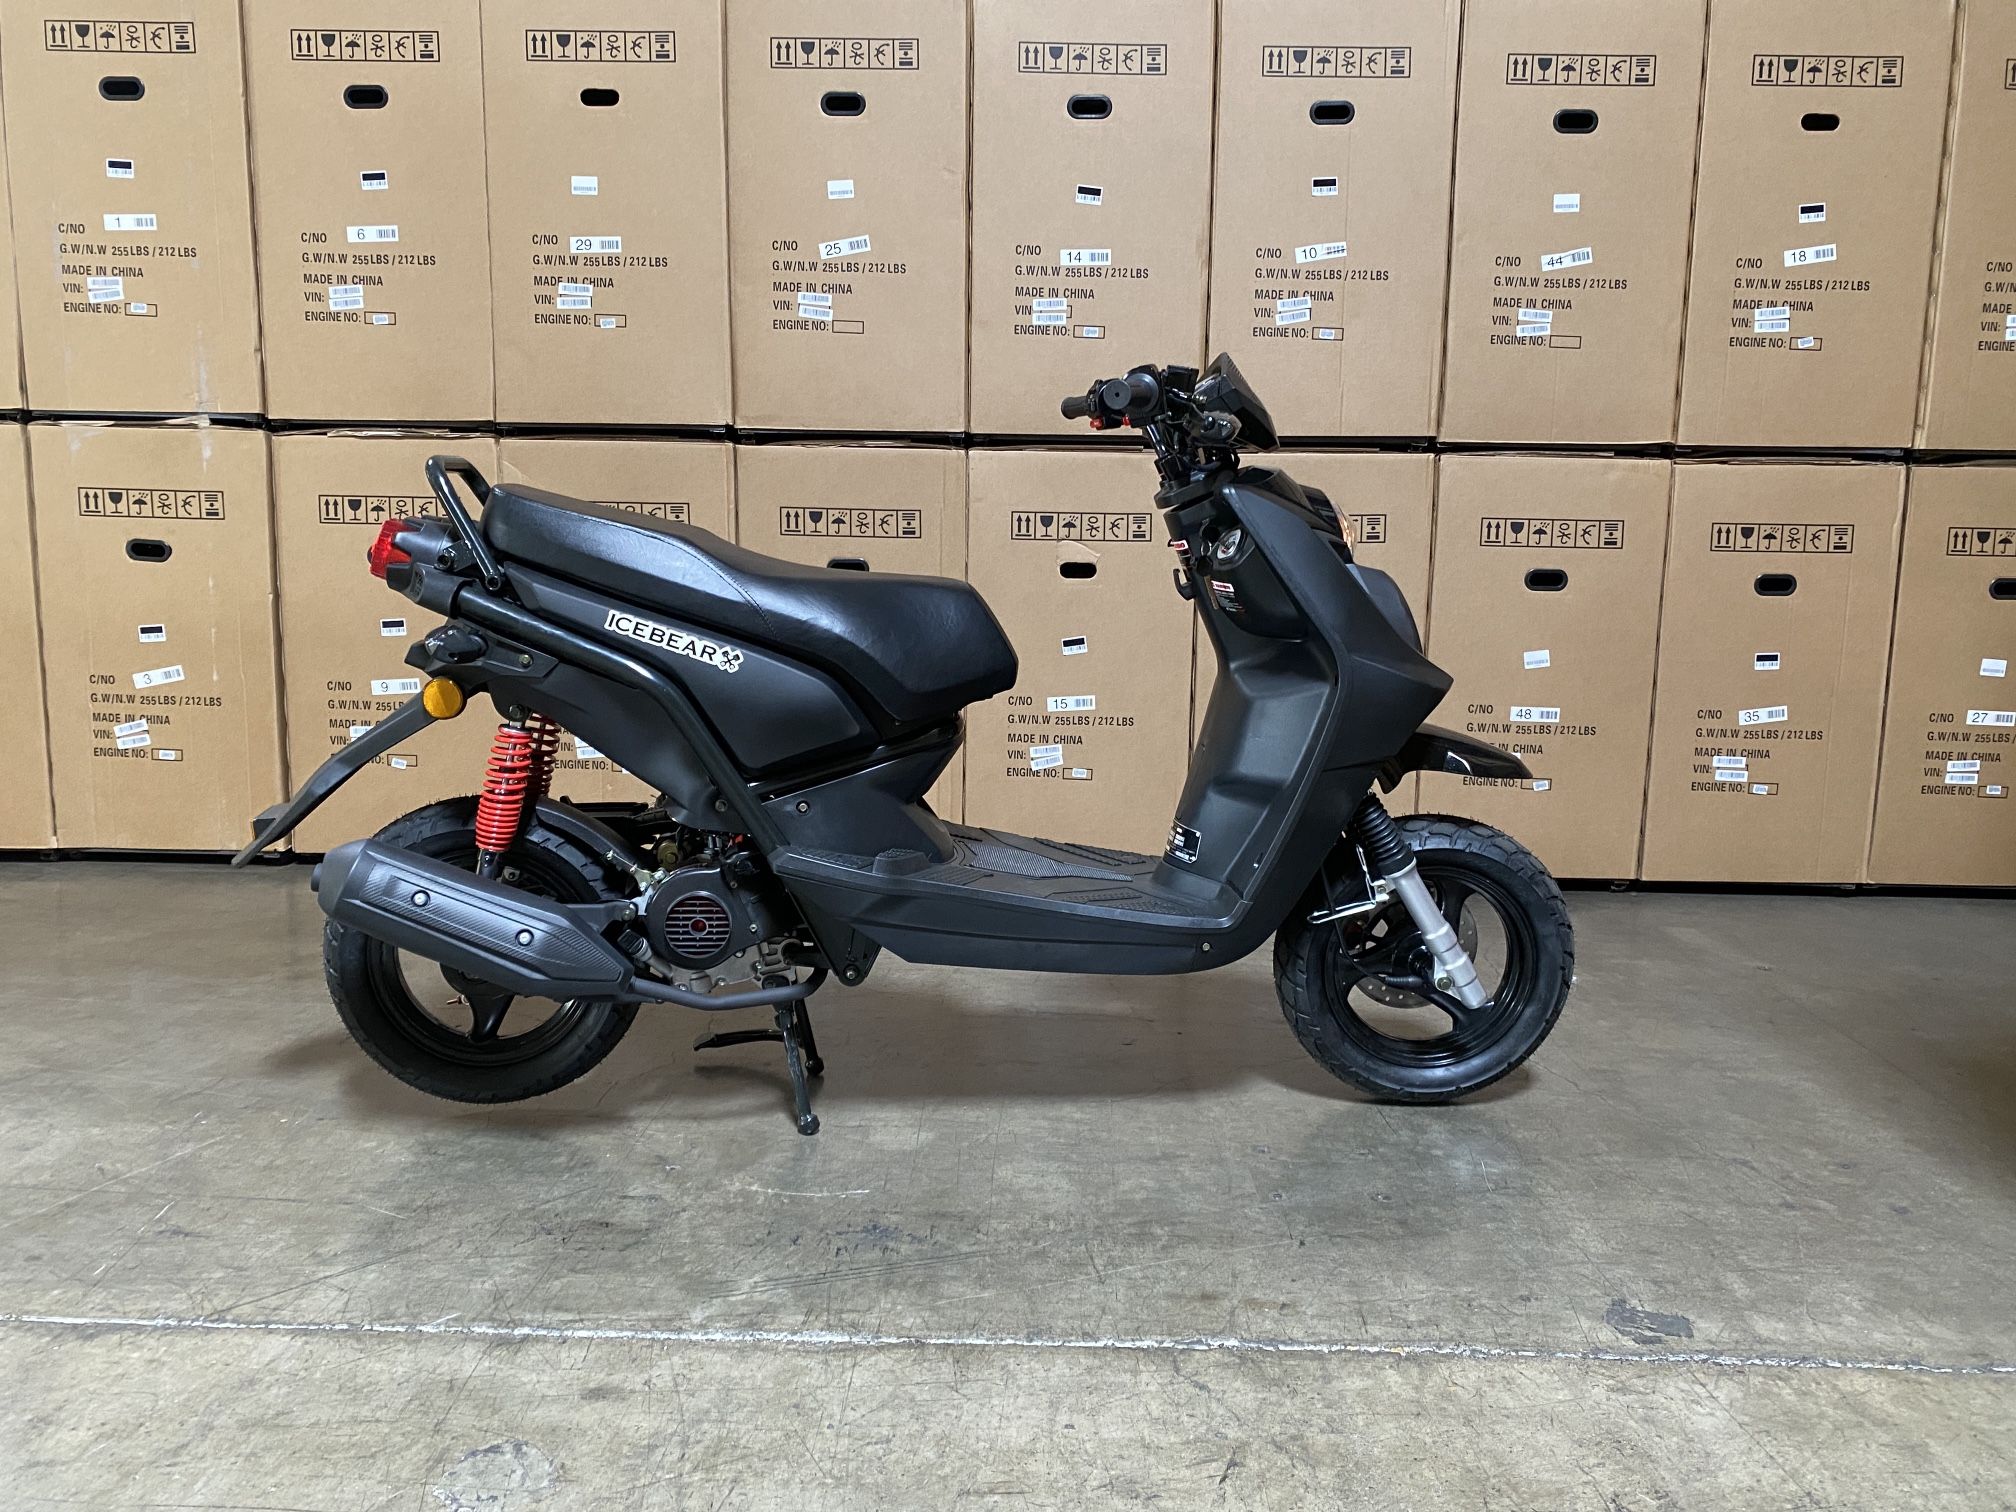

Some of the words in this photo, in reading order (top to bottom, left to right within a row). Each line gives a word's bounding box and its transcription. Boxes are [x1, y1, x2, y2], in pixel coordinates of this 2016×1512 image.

[114, 217, 121, 228] 1
[58, 223, 85, 234] C/NO
[301, 233, 327, 243] C/NO
[357, 228, 365, 240] 6
[532, 234, 558, 245] C/NO
[575, 238, 592, 251] 29
[772, 241, 798, 251] C/NO
[825, 243, 842, 256] 25
[1016, 245, 1041, 256] C/NO
[159, 247, 175, 256] 212
[1256, 248, 1281, 259] C/NO
[1302, 247, 1318, 260] 10
[1791, 250, 1807, 263] 18
[398, 255, 415, 264] 212
[630, 257, 646, 266] 212
[1066, 251, 1082, 263] 14
[1495, 256, 1521, 267] C/NO
[1547, 256, 1563, 268] 44
[869, 263, 885, 273] 212
[1736, 258, 1762, 269] C/NO
[1987, 262, 2012, 272] C/NO
[62, 265, 92, 275] MADE
[96, 266, 106, 276] IN
[112, 267, 143, 277] CHINA
[1111, 268, 1127, 277] 212
[1351, 270, 1367, 280] 212
[304, 274, 333, 284] MADE
[337, 275, 347, 284] IN
[352, 275, 383, 286] CHINA
[1590, 279, 1606, 288] 212
[1831, 280, 1849, 290] 212
[63, 283, 83, 293] VIN:
[773, 282, 802, 292] MADE
[806, 283, 816, 293] IN
[821, 283, 852, 294] CHINA
[1015, 286, 1044, 297] MADE
[1049, 288, 1058, 298] IN
[1064, 288, 1094, 299] CHINA
[304, 292, 324, 302] VIN:
[534, 294, 554, 304] VIN:
[1255, 289, 1284, 300] MADE
[64, 302, 102, 313] ENGINE
[104, 304, 121, 314] NO:
[773, 300, 792, 310] VIN:
[1493, 297, 1522, 308] MADE
[1526, 298, 1536, 308] IN
[1541, 299, 1572, 309] CHINA
[1254, 308, 1273, 318] VIN:
[1983, 303, 2012, 314] MADE
[305, 311, 341, 322] ENGINE
[344, 312, 361, 322] NO:
[535, 314, 571, 324] ENGINE
[574, 315, 591, 325] NO:
[1492, 316, 1511, 325] VIN:
[773, 320, 809, 330] ENGINE
[812, 321, 828, 331] NO:
[1732, 318, 1751, 328] VIN:
[1981, 322, 2000, 331] VIN:
[1014, 325, 1050, 335] ENGINE
[1053, 326, 1070, 336] NO:
[1253, 327, 1289, 337] ENGINE
[1292, 328, 1308, 338] NO:
[1529, 336, 1546, 346] NO:
[1730, 337, 1767, 347] ENGINE
[1769, 338, 1786, 348] NO:
[1978, 341, 2015, 351] ENGINE
[608, 613, 717, 662] ICEBEAR
[89, 674, 115, 684] C/NO
[143, 673, 152, 685] 3
[327, 681, 351, 691] C/NO
[380, 681, 389, 692] 9
[185, 696, 201, 705] 212
[1008, 696, 1032, 706] C/NO
[1053, 698, 1068, 710] 15
[1468, 704, 1493, 714] C/NO
[1516, 708, 1532, 720] 48
[93, 713, 121, 723] MADE
[1697, 710, 1722, 720] C/NO
[1744, 711, 1760, 723] 35
[1929, 713, 1954, 723] C/NO
[1971, 712, 1988, 723] 27
[1098, 717, 1114, 725] 212
[93, 729, 112, 739] VIN:
[1560, 726, 1576, 734] 212
[1787, 730, 1803, 739] 212
[330, 736, 349, 745] VIN:
[1008, 733, 1035, 743] MADE
[1039, 735, 1049, 743] IN
[1053, 735, 1082, 745] CHINA
[132, 749, 148, 758] NO:
[1513, 744, 1543, 754] CHINA
[1695, 747, 1722, 757] MADE
[1726, 749, 1736, 757] IN
[1008, 750, 1026, 759] VIN:
[1926, 751, 1953, 761] MADE
[1957, 752, 1967, 760] IN
[592, 760, 609, 770] NO:
[1693, 764, 1712, 773] VIN:
[1043, 768, 1060, 778] NO:
[1924, 768, 1942, 777] VIN:
[1691, 782, 1726, 792] ENGINE
[1729, 783, 1745, 792] NO:
[1921, 785, 1956, 795] ENGINE
[1958, 786, 1975, 795] NO:
